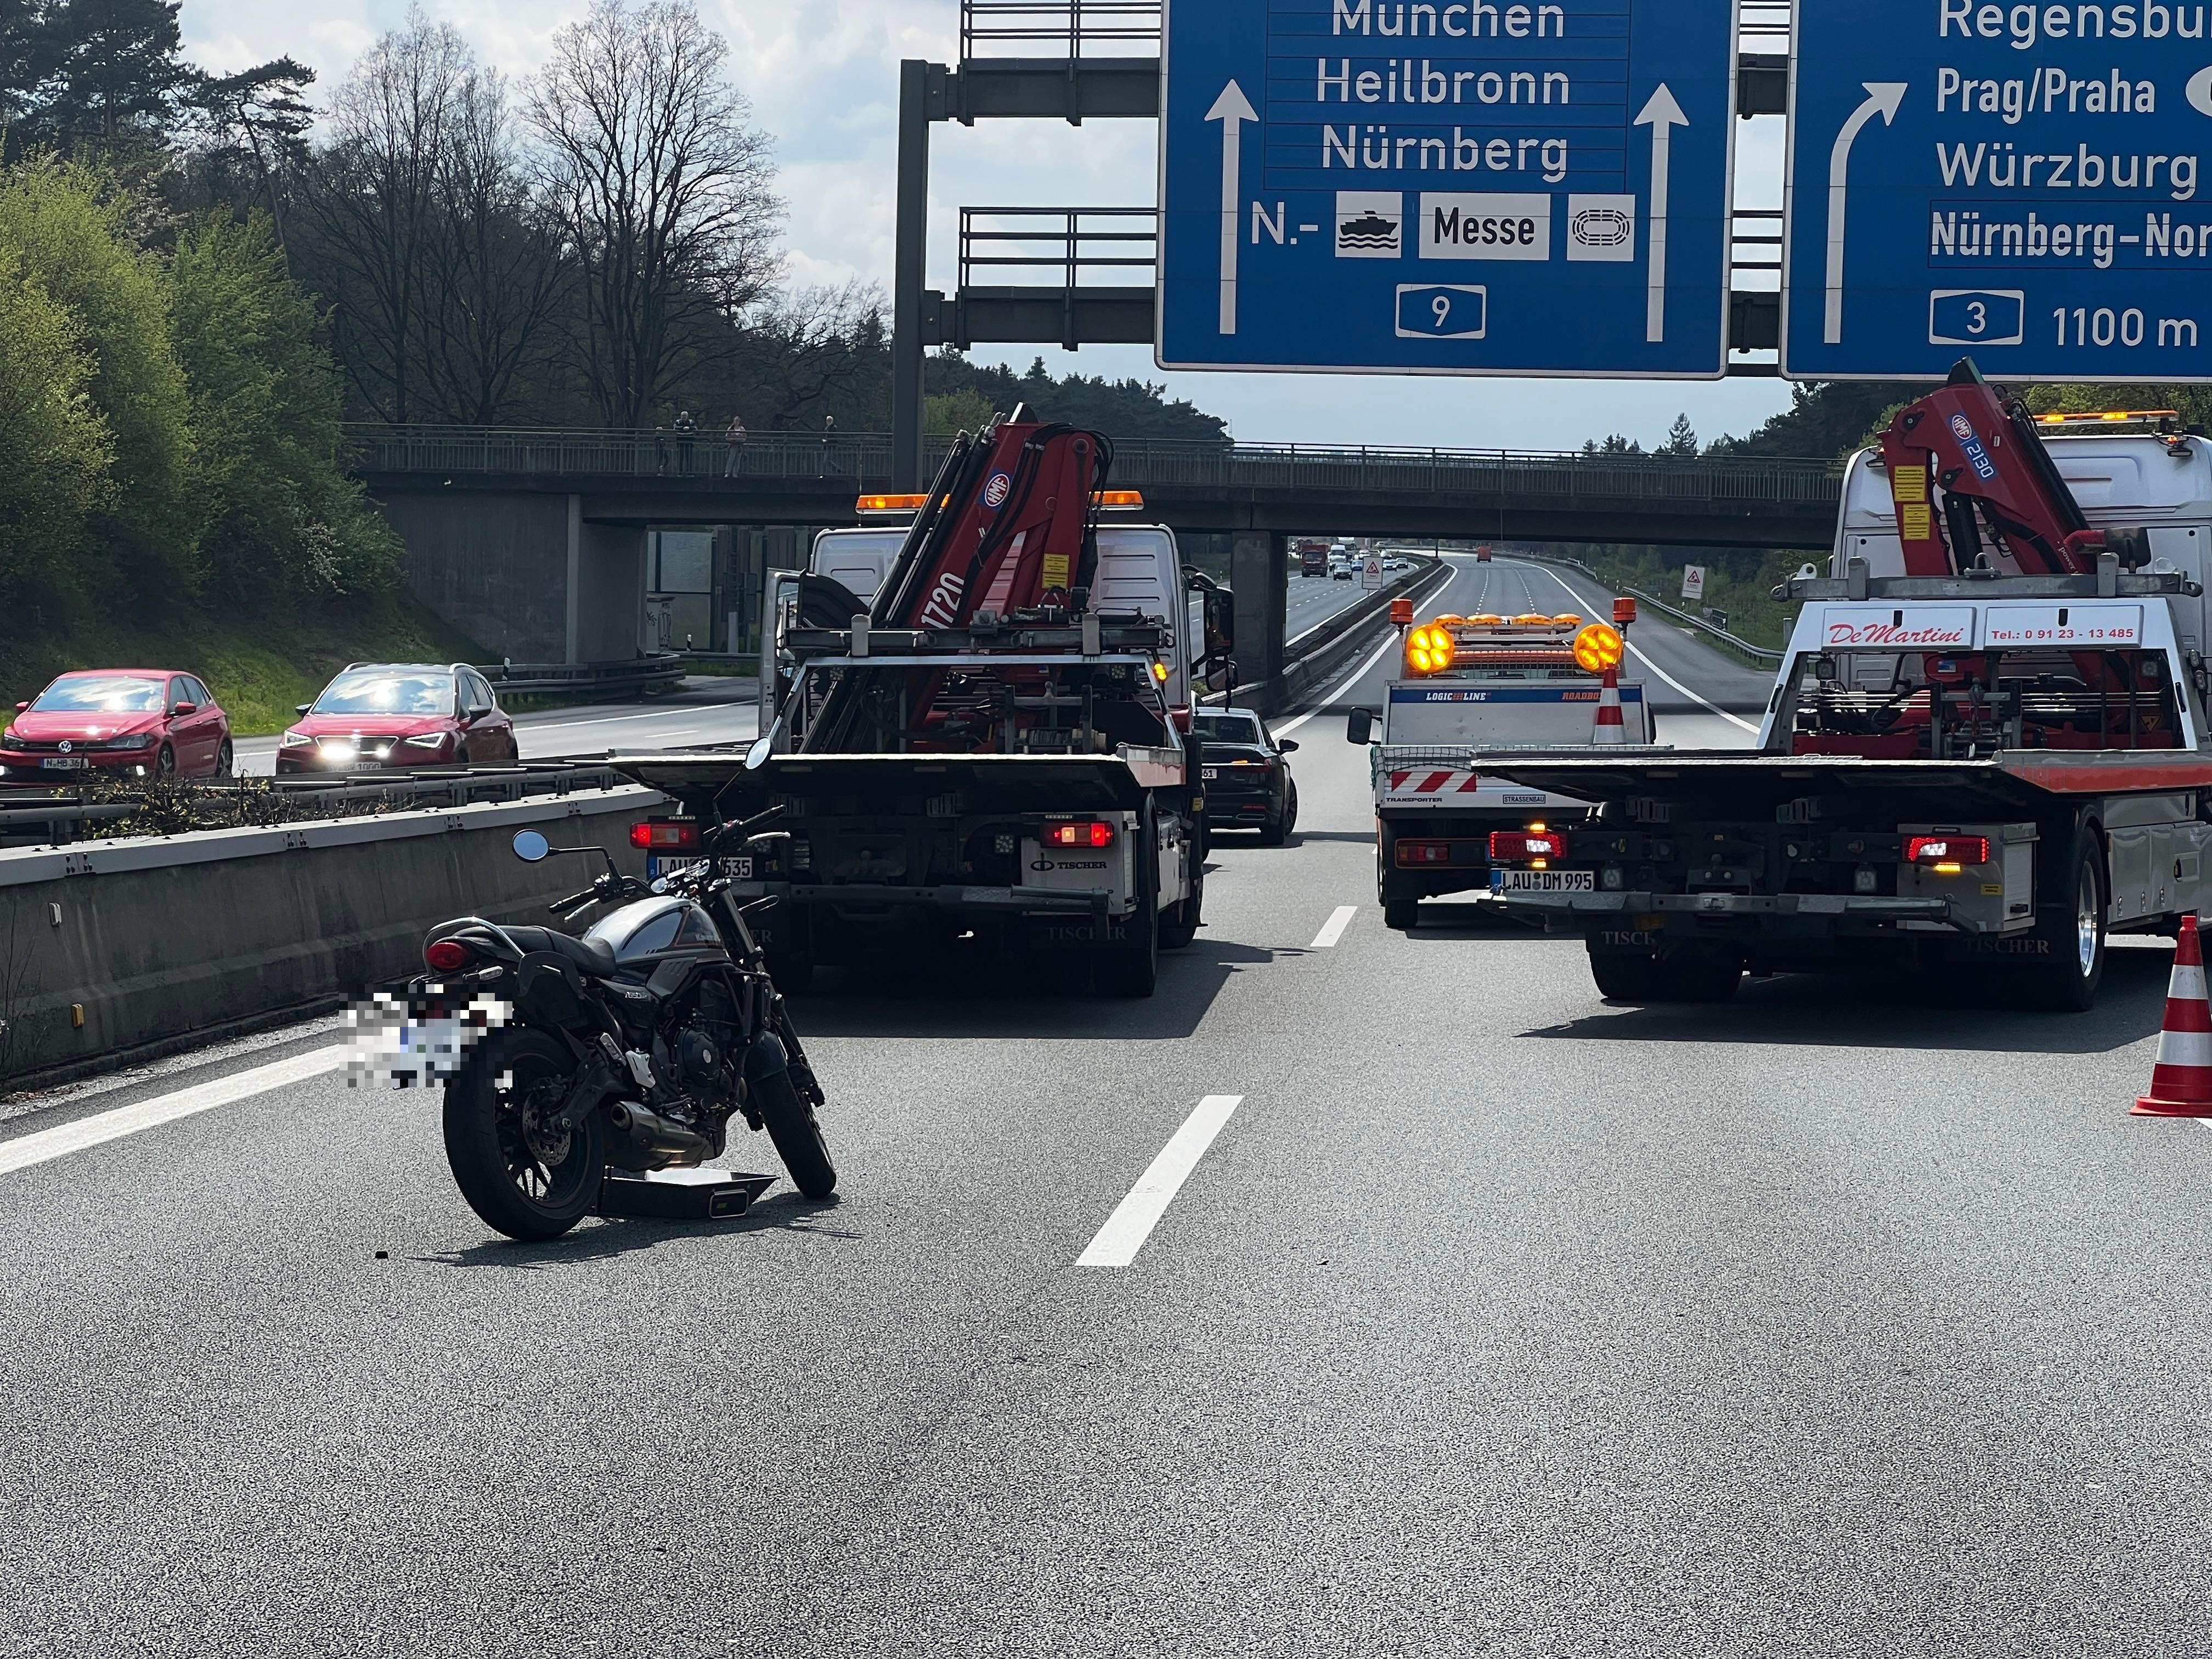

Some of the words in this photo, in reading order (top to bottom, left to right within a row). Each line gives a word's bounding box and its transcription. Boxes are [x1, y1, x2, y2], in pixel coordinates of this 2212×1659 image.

[1940, 0, 2212, 49] Regensbu
[1317, 58, 1570, 104] Heilbronn
[1937, 67, 2155, 125] Prag/Praha
[1323, 125, 1567, 183] Nürnberg
[1936, 143, 2197, 200] Würzburg
[1434, 207, 1535, 245] Messe
[1432, 296, 1450, 327] 9
[1967, 302, 1985, 333] 3
[2053, 307, 2143, 346] 1100
[2158, 319, 2197, 346] m
[1954, 417, 1970, 436] HMF
[1967, 443, 1994, 478] 2130
[988, 477, 1007, 503] HMF
[921, 573, 964, 629] 1720
[1991, 630, 2020, 639] Tel.:
[2025, 630, 2033, 639] 0
[2038, 630, 2052, 639] 91
[2058, 629, 2074, 639] 23
[2089, 629, 2104, 638] 13
[2108, 629, 2134, 637] 485
[1426, 692, 1453, 701] LOGIC
[1463, 692, 1487, 701] LINE
[1562, 692, 1601, 700] ROADBO
[1503, 873, 1531, 890] LAU
[1543, 873, 1561, 890] DM
[1565, 873, 1592, 890] 995
[1046, 926, 1126, 940] TISCR
